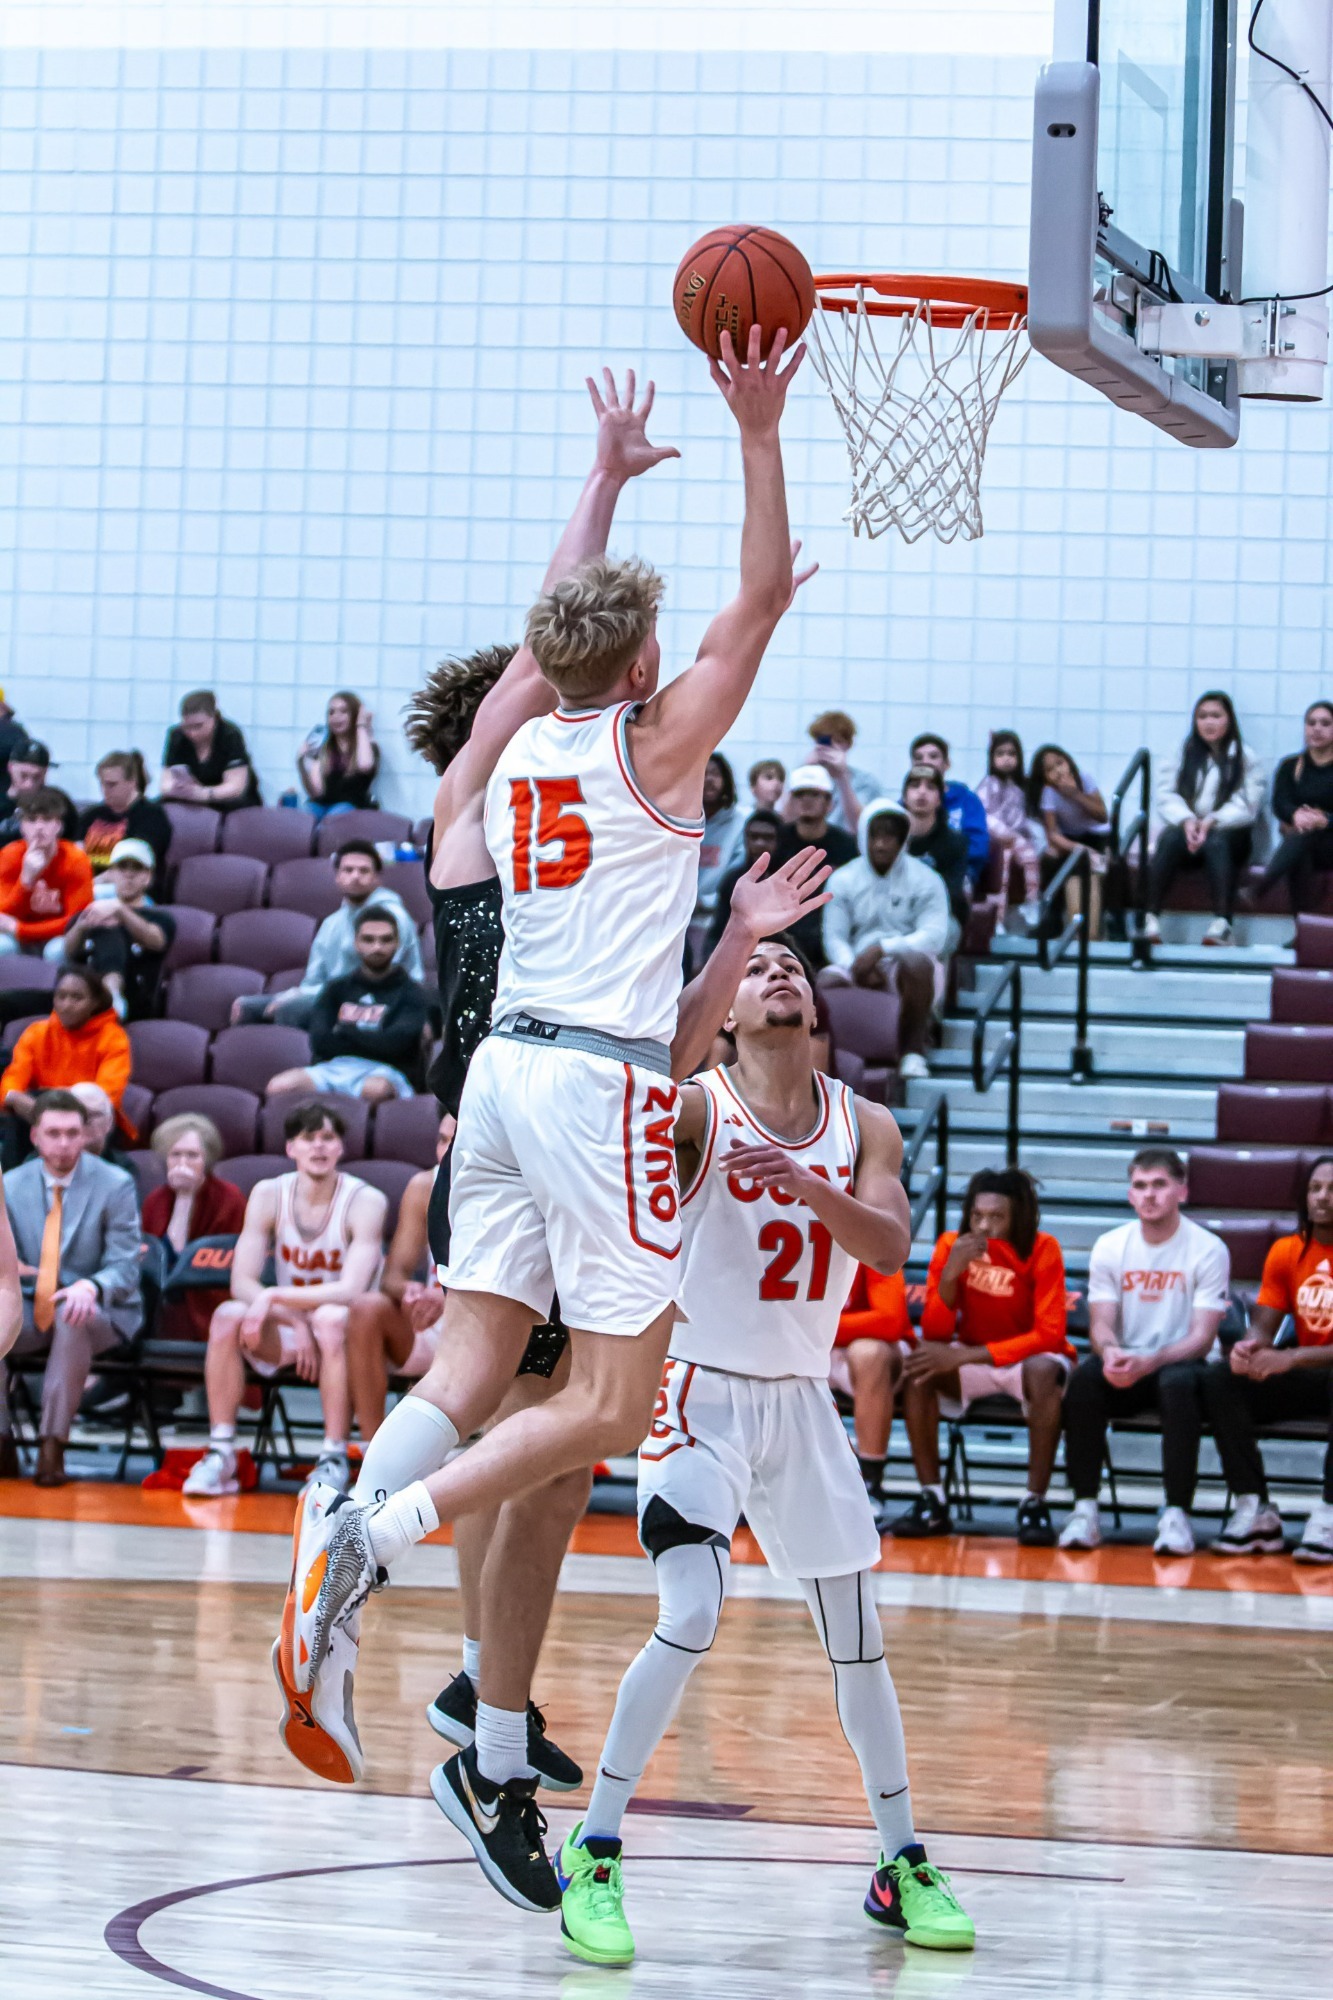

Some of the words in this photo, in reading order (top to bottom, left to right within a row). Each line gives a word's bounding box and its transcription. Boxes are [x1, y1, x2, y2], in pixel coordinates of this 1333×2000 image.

[508, 775, 594, 896] 15
[641, 1085, 679, 1223] OUAZ
[757, 1219, 834, 1302] 21
